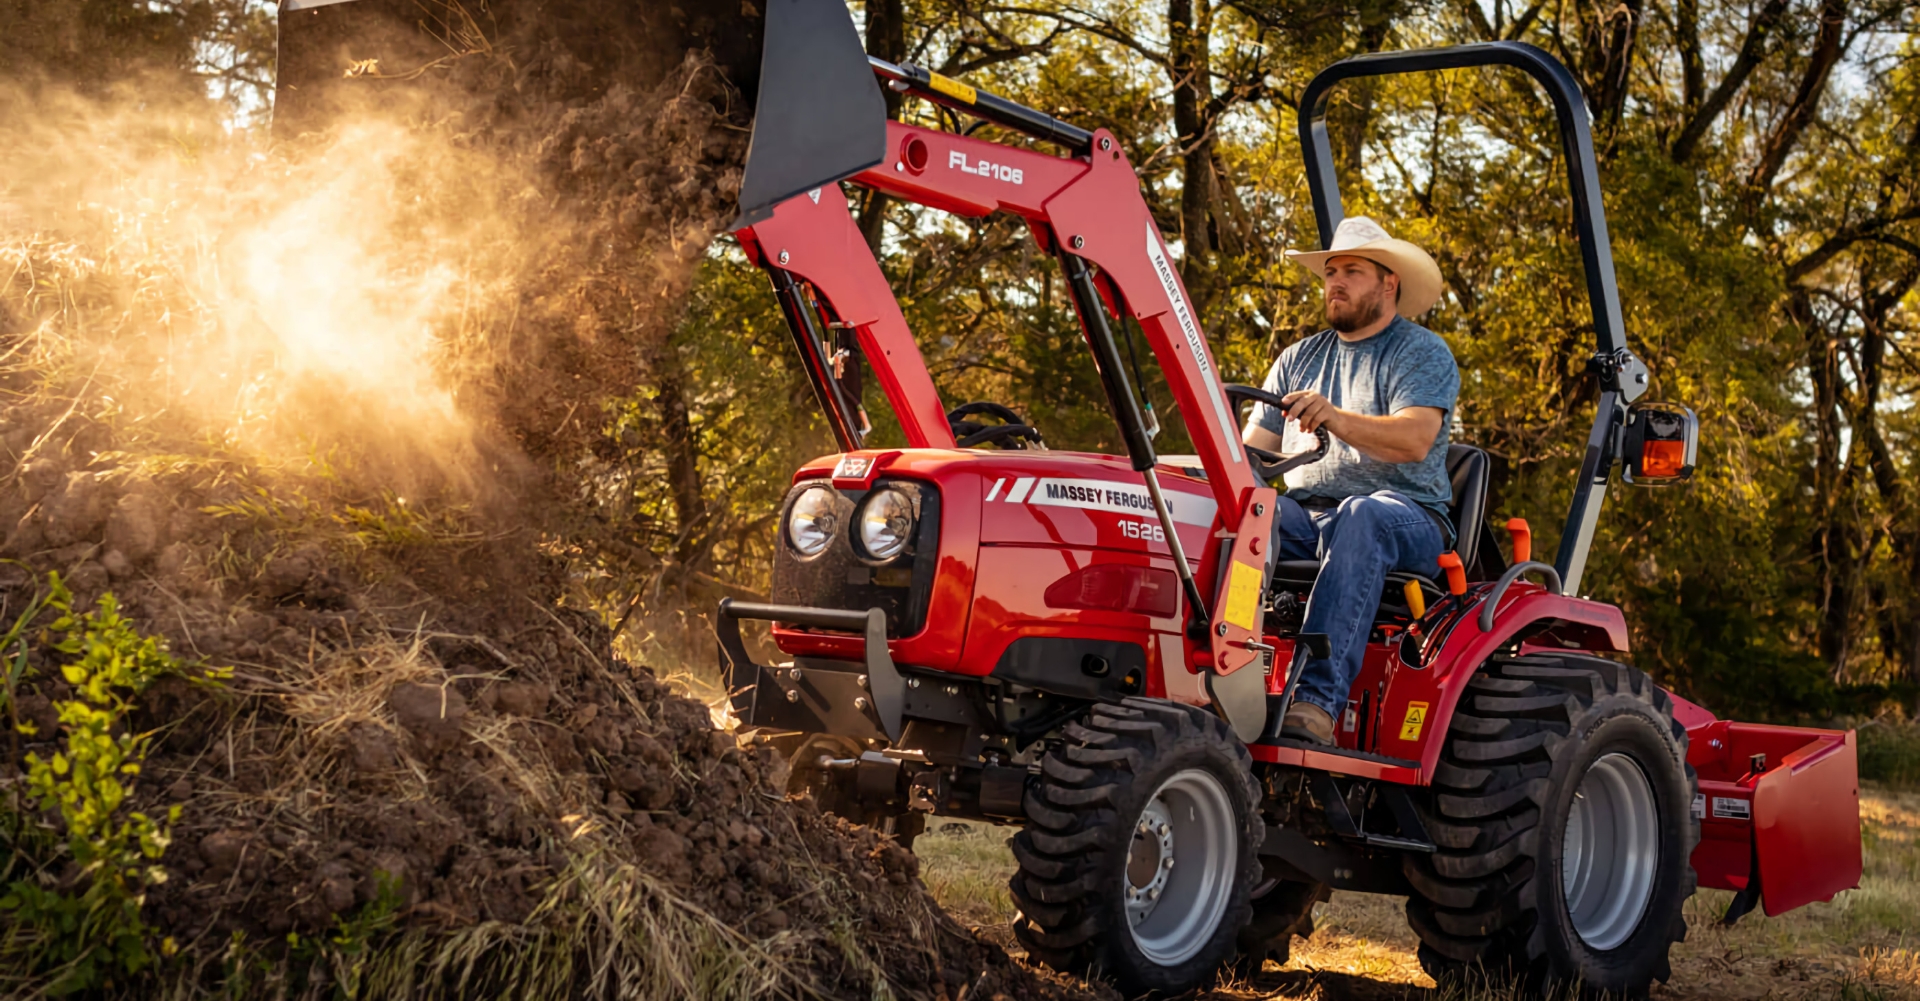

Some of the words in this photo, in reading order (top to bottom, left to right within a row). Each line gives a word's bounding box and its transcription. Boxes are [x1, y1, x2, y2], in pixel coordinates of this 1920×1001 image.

[1155, 254, 1182, 304] MASSEY
[1178, 306, 1208, 372] FERGUSON
[1046, 483, 1103, 504] MASSEY
[1106, 489, 1174, 515] FERGUSN
[1118, 519, 1166, 543] 1526
